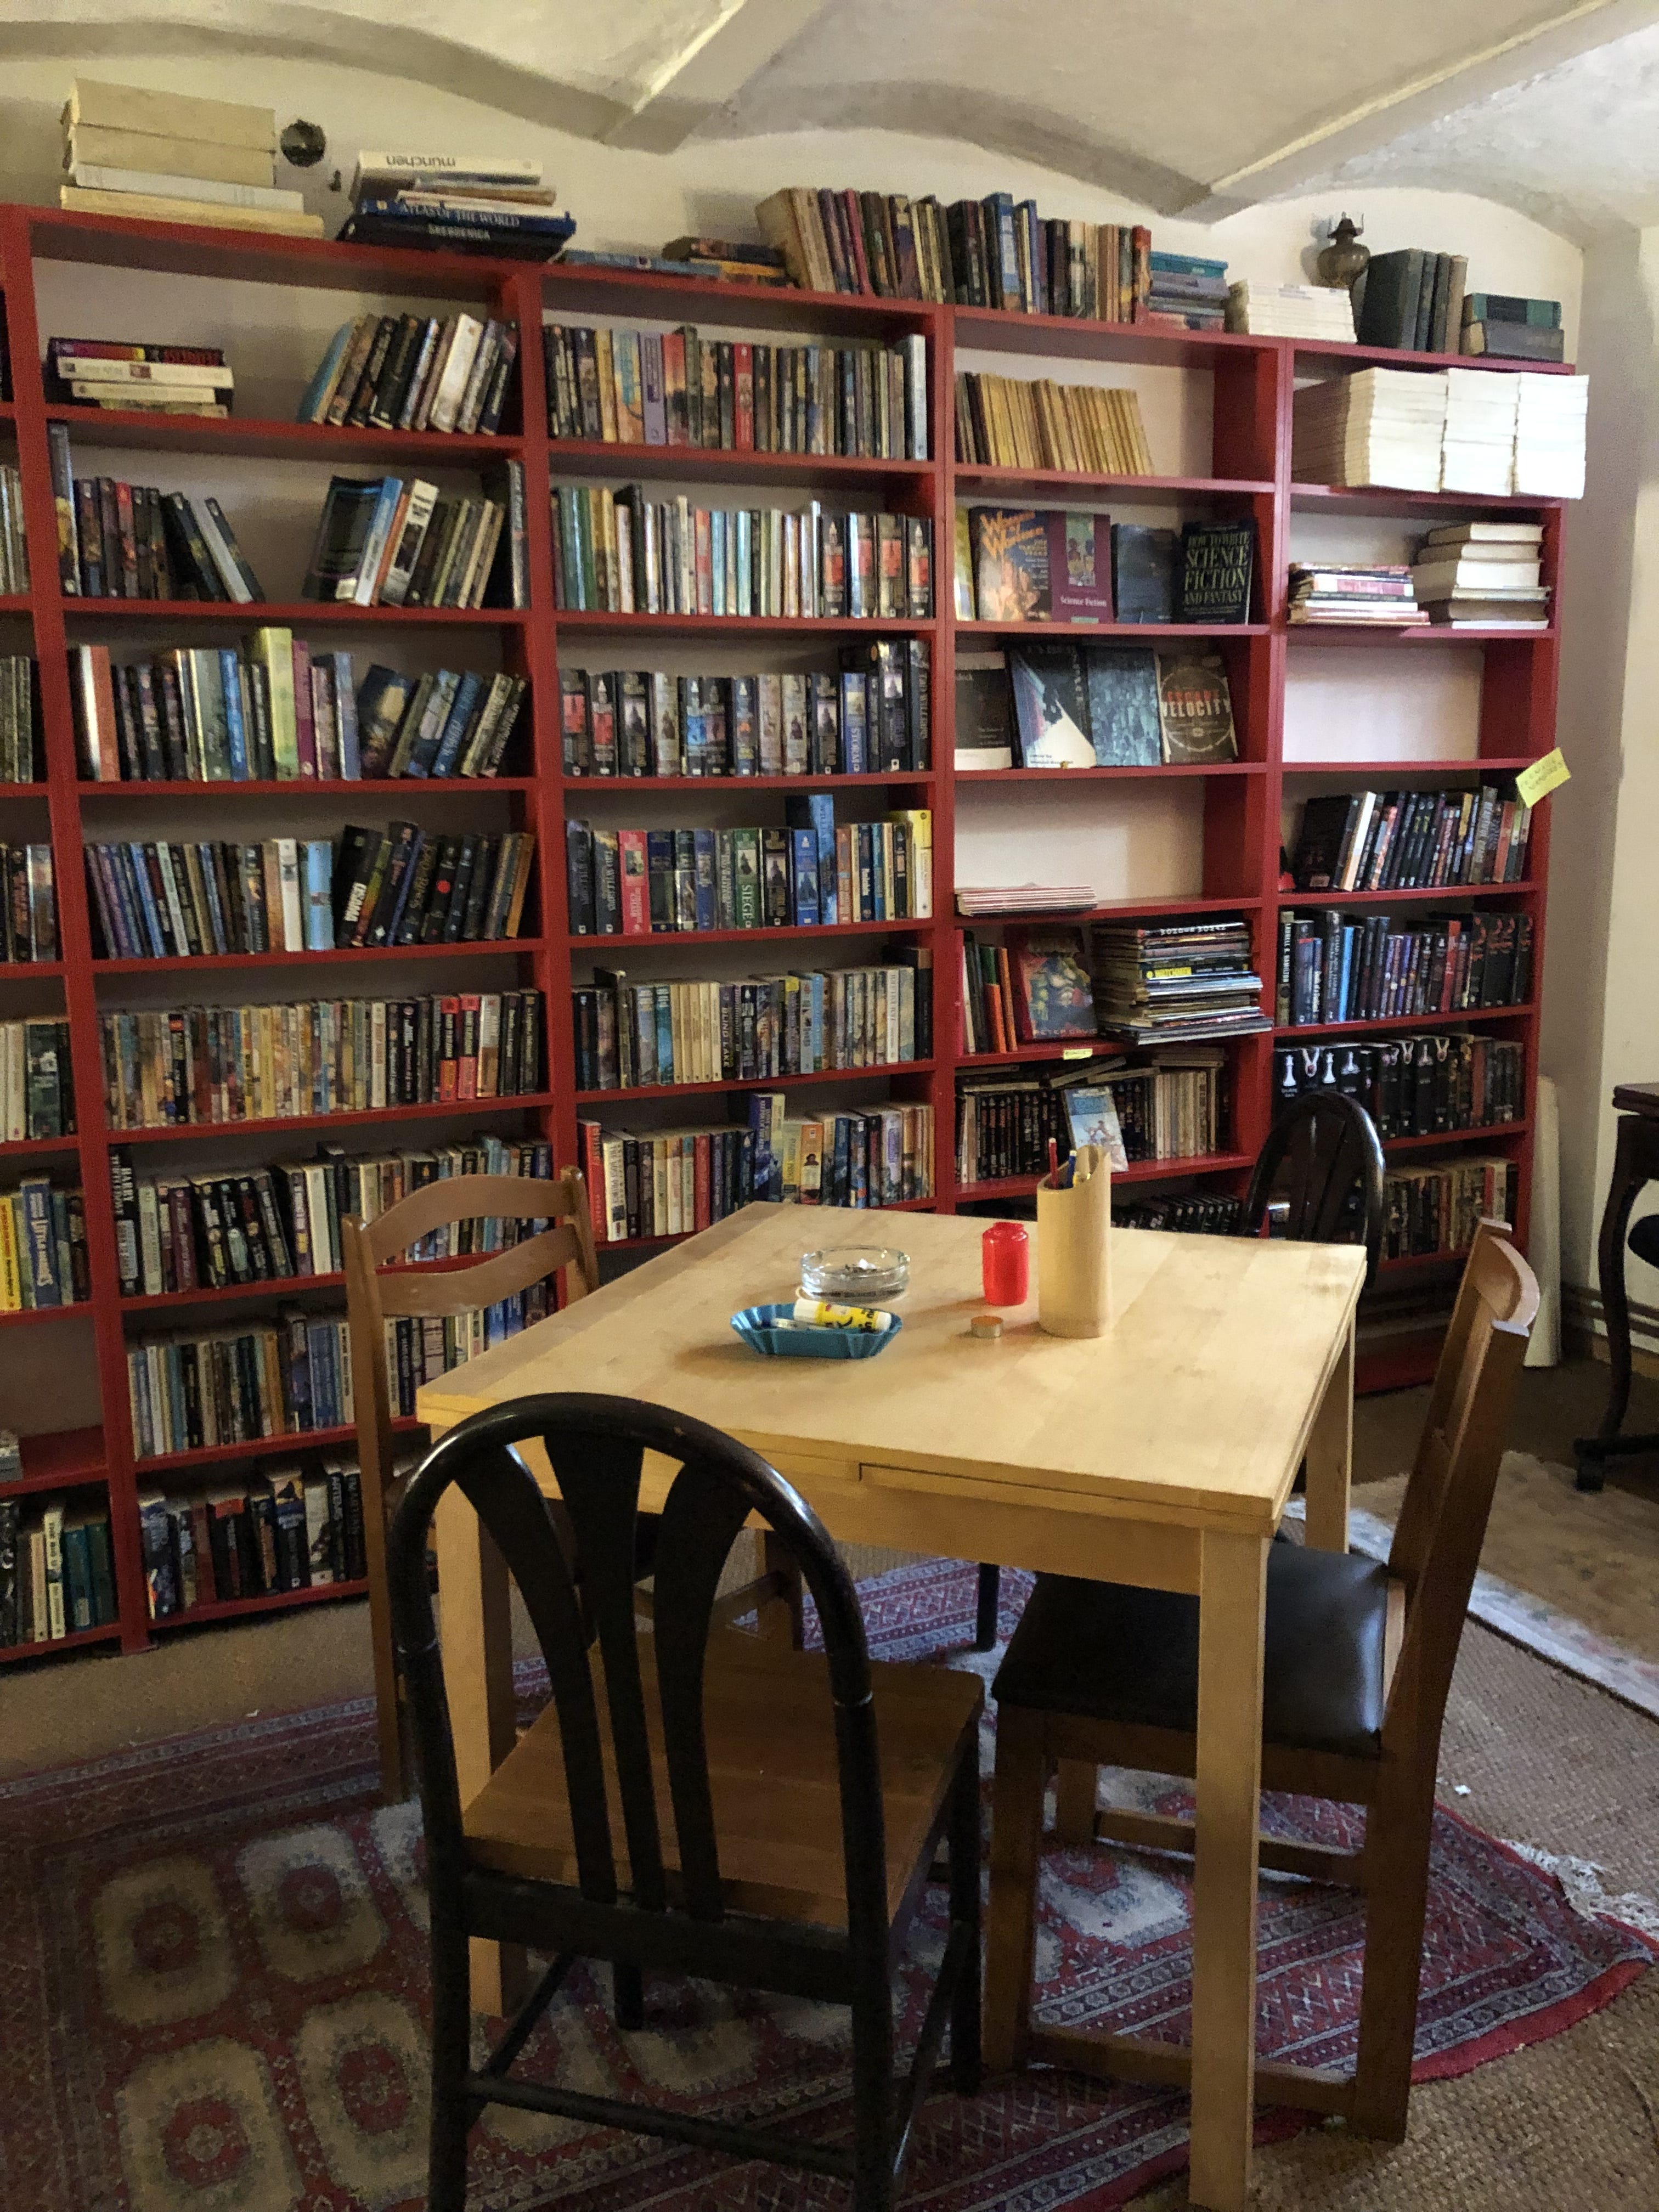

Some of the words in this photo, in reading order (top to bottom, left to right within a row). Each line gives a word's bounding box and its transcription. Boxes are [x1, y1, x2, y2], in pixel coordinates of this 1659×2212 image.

[455, 208, 477, 223] THE
[479, 212, 520, 228] WORLD
[1185, 545, 1249, 569] SCIENCE
[1184, 568, 1246, 591] FICTION
[1060, 596, 1083, 606] Science
[1084, 597, 1107, 608] Fiction
[1183, 592, 1203, 605] AND
[1204, 590, 1242, 605] FANTASY
[1166, 689, 1220, 702] ESCAPE
[1160, 698, 1232, 718] VELOCITY
[740, 884, 752, 921] SIEGE
[721, 1007, 730, 1037] BLIND
[722, 1041, 731, 1068] LAKE
[110, 1154, 124, 1215] TURTLEDOVE
[123, 1167, 134, 1202] HARRY
[331, 1476, 343, 1521] ARTEMIS
